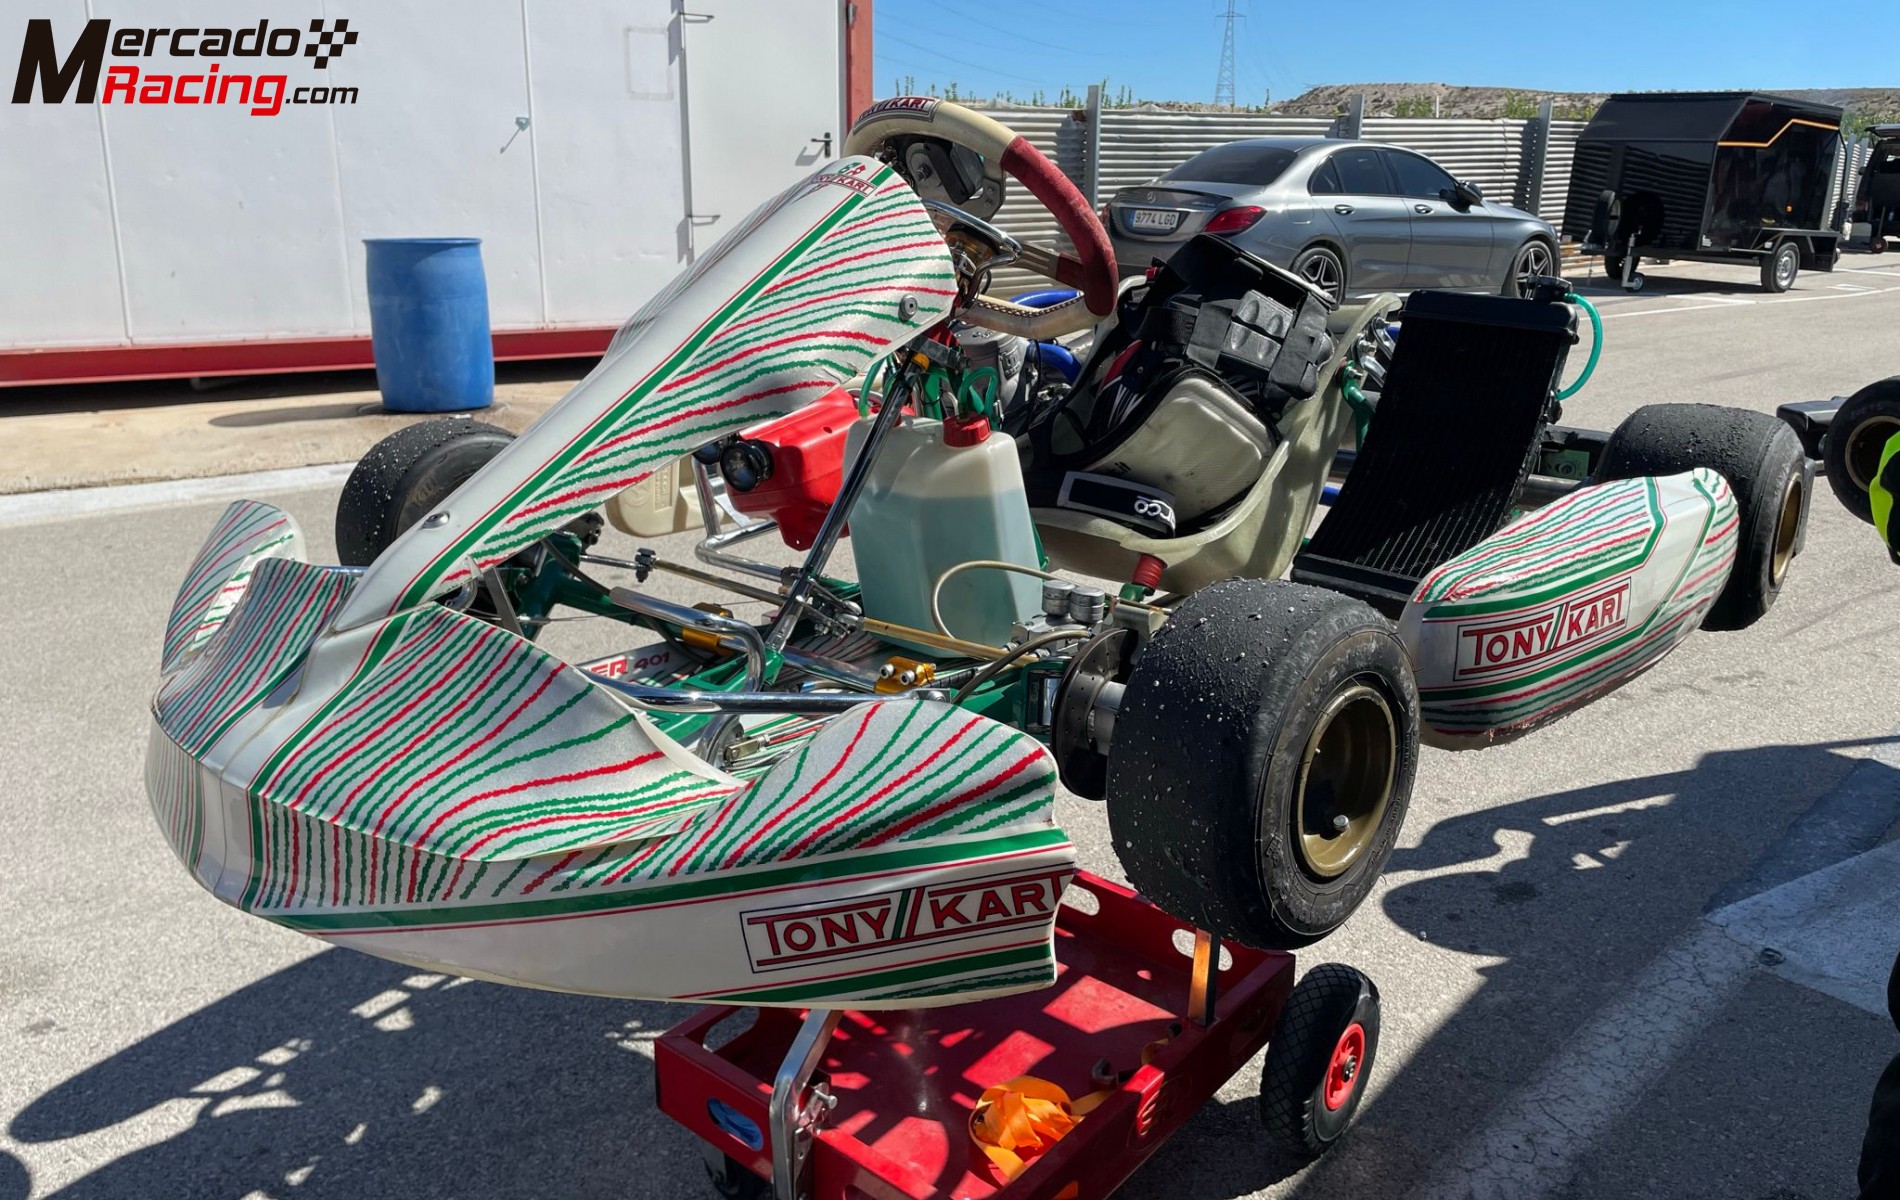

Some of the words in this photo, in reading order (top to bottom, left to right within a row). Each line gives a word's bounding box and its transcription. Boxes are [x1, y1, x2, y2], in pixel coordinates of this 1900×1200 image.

[888, 97, 935, 111] KART
[1135, 212, 1156, 223] 9774
[1158, 214, 1176, 226] LGD
[1463, 612, 1554, 666] TONY
[1567, 583, 1630, 641] KART
[634, 652, 670, 669] 401
[747, 897, 892, 956] TONY
[928, 868, 1075, 929] KART
